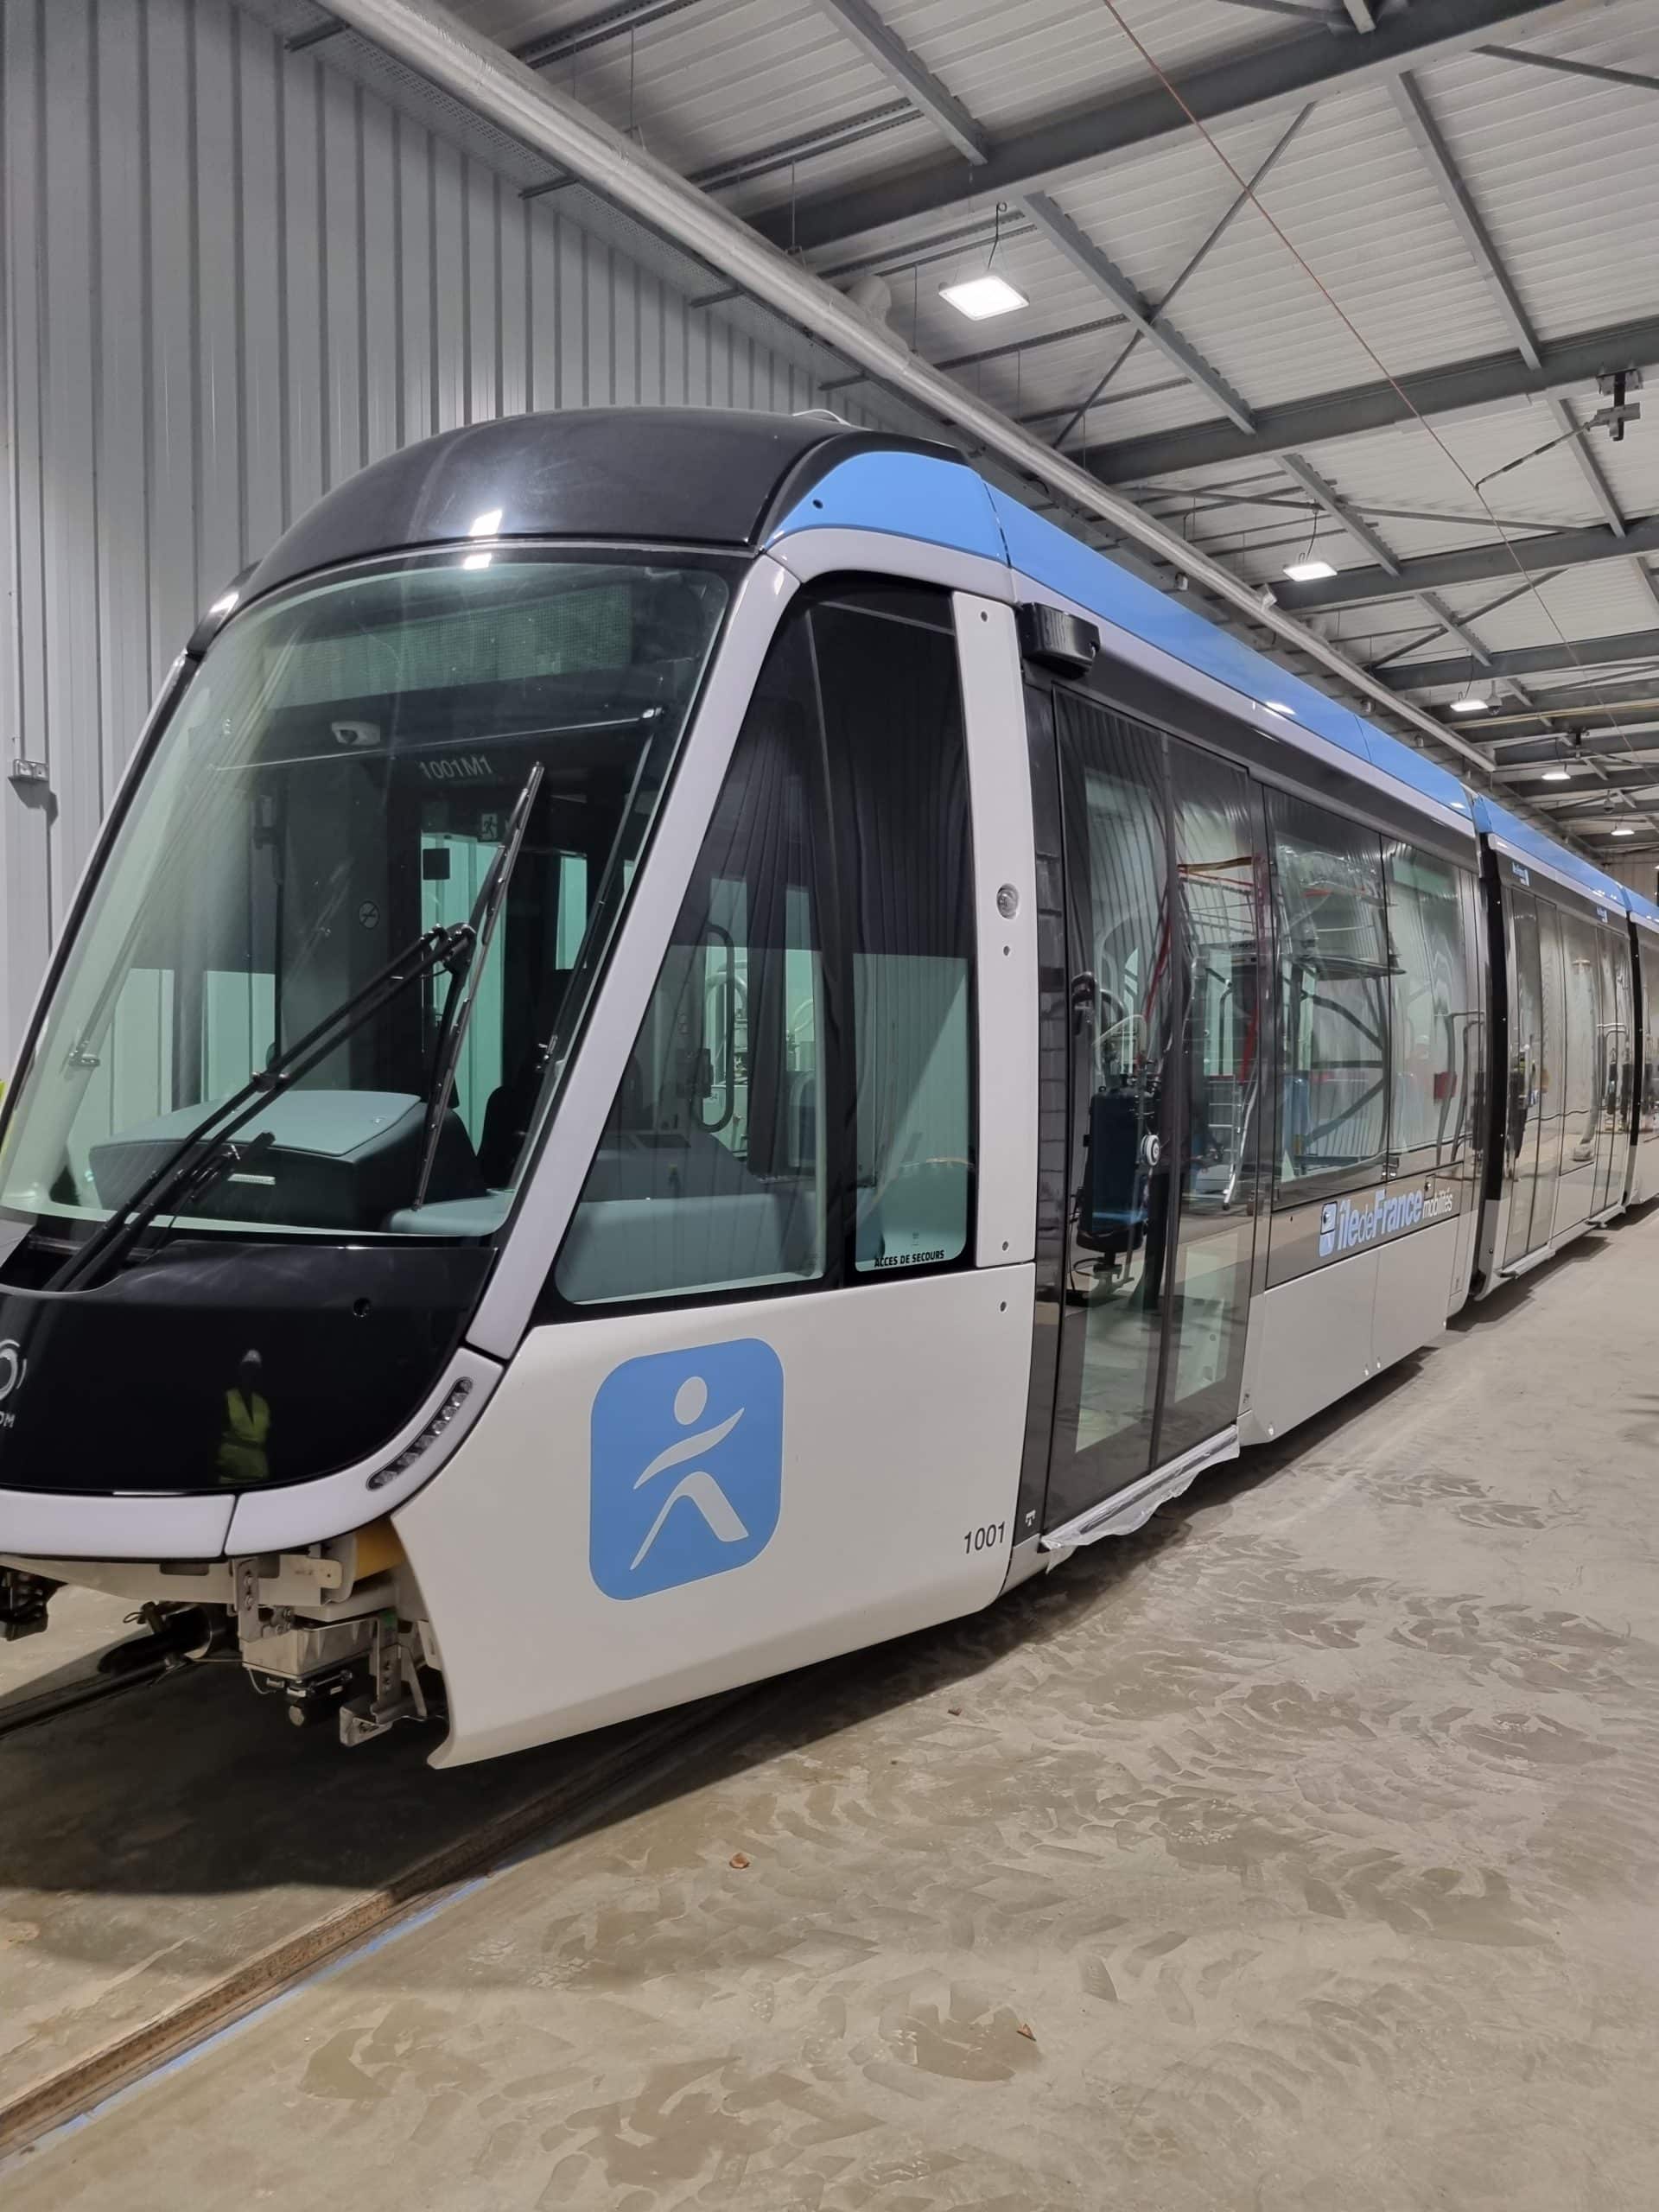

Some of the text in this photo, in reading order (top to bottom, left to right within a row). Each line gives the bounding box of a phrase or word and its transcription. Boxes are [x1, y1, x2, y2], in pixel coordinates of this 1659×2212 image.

[419, 754, 493, 779] 1001M1
[874, 1249, 945, 1268] ACCES DE SECOURS
[964, 1521, 1005, 1554] 1001
